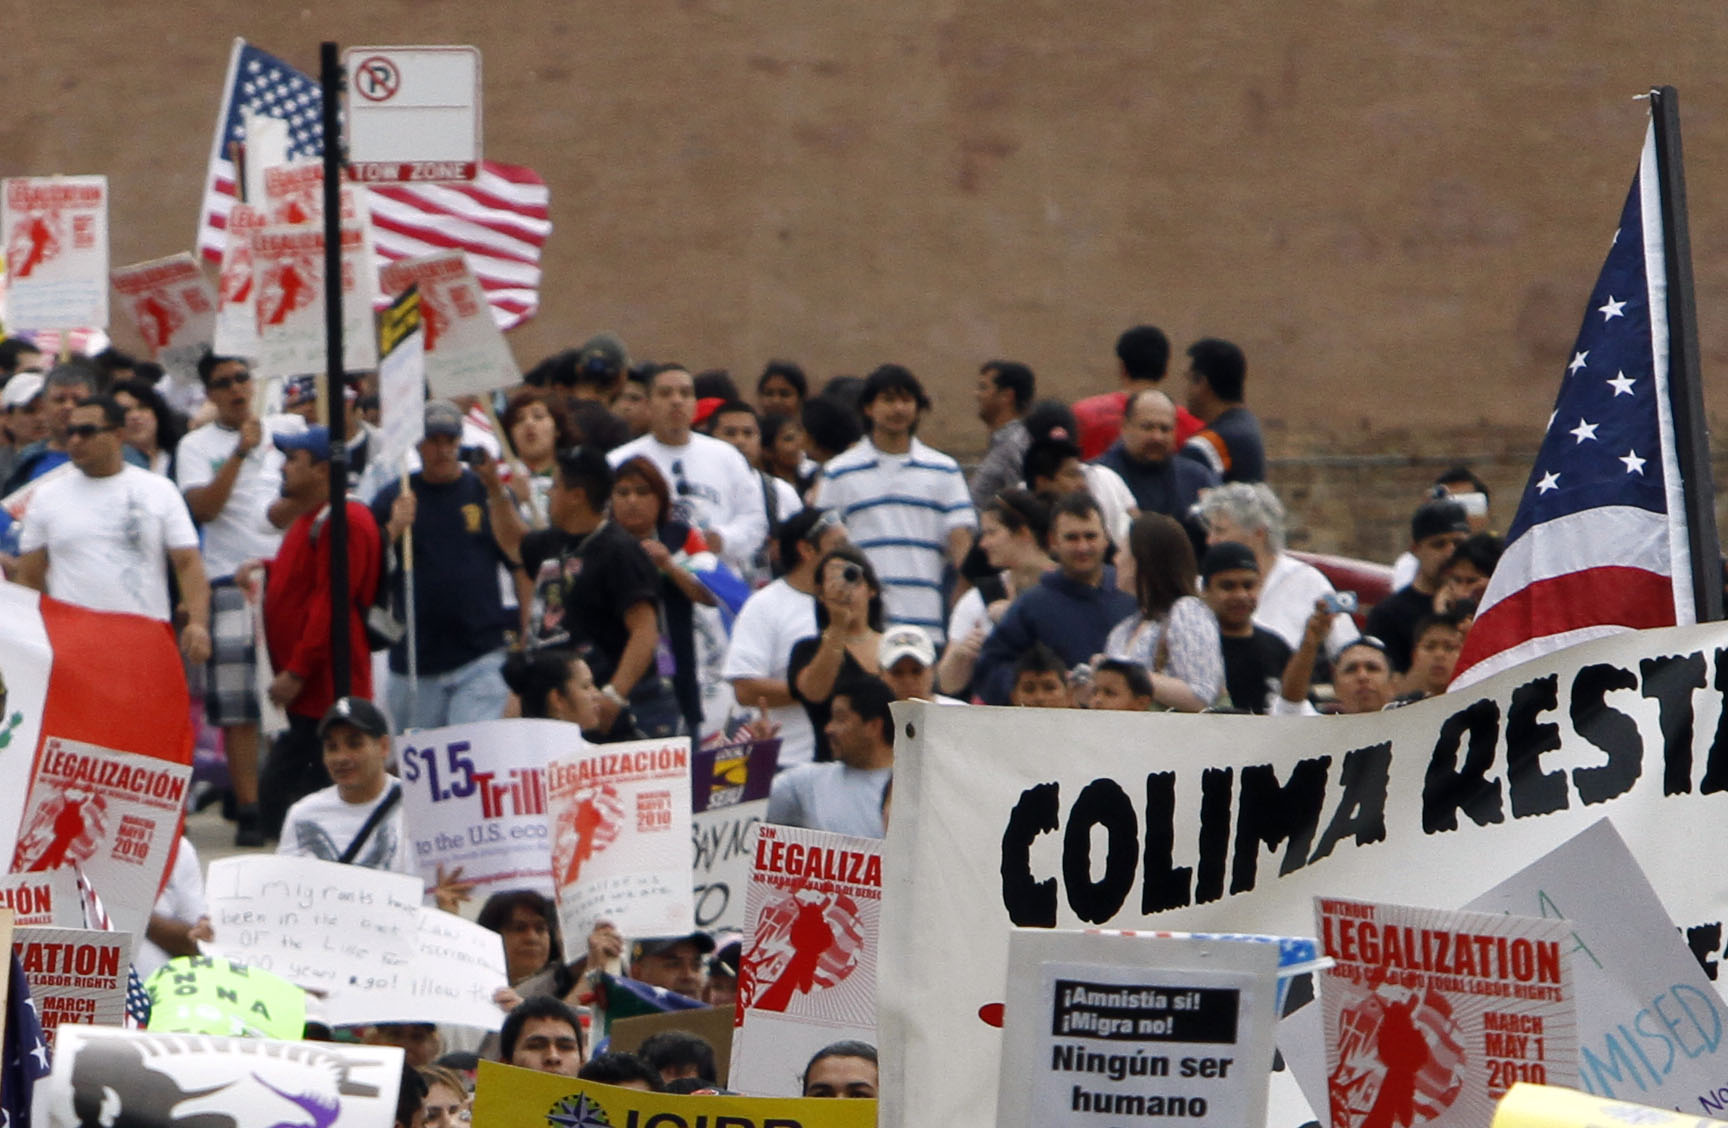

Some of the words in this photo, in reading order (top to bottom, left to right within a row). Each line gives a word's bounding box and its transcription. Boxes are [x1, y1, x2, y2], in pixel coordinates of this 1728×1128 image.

[411, 162, 467, 180] ZONE
[41, 750, 186, 802] LEGALIZACIÓN
[402, 740, 477, 804] $1.5
[548, 745, 688, 793] LEGALIZACIÓN
[1000, 739, 1393, 929] COLIMA
[1421, 646, 1728, 836] REST
[636, 810, 672, 826] 2010
[758, 825, 778, 839] SIN
[114, 837, 150, 860] 2010
[435, 831, 465, 852] the
[467, 823, 507, 845] U.S.
[754, 838, 883, 888] LEGALIZA
[1321, 898, 1376, 920] WITHOUT
[1322, 916, 1562, 985] LEGALIZATION
[34, 975, 71, 988] LABOR
[73, 977, 117, 990] RIGHTS
[42, 995, 96, 1013] MARCH
[1062, 985, 1169, 1014] ¡Amnistía
[41, 1011, 82, 1029] MAY
[1062, 1010, 1135, 1037] ¡Migra
[1138, 1016, 1175, 1035] no!
[1484, 1011, 1545, 1036] MARCH
[1484, 1034, 1530, 1060] MAY
[1533, 1036, 1545, 1061] 1
[1051, 1044, 1171, 1082] Ningún
[1179, 1054, 1235, 1080] ser
[1487, 1059, 1548, 1088] 2010
[1071, 1084, 1209, 1119] humano
